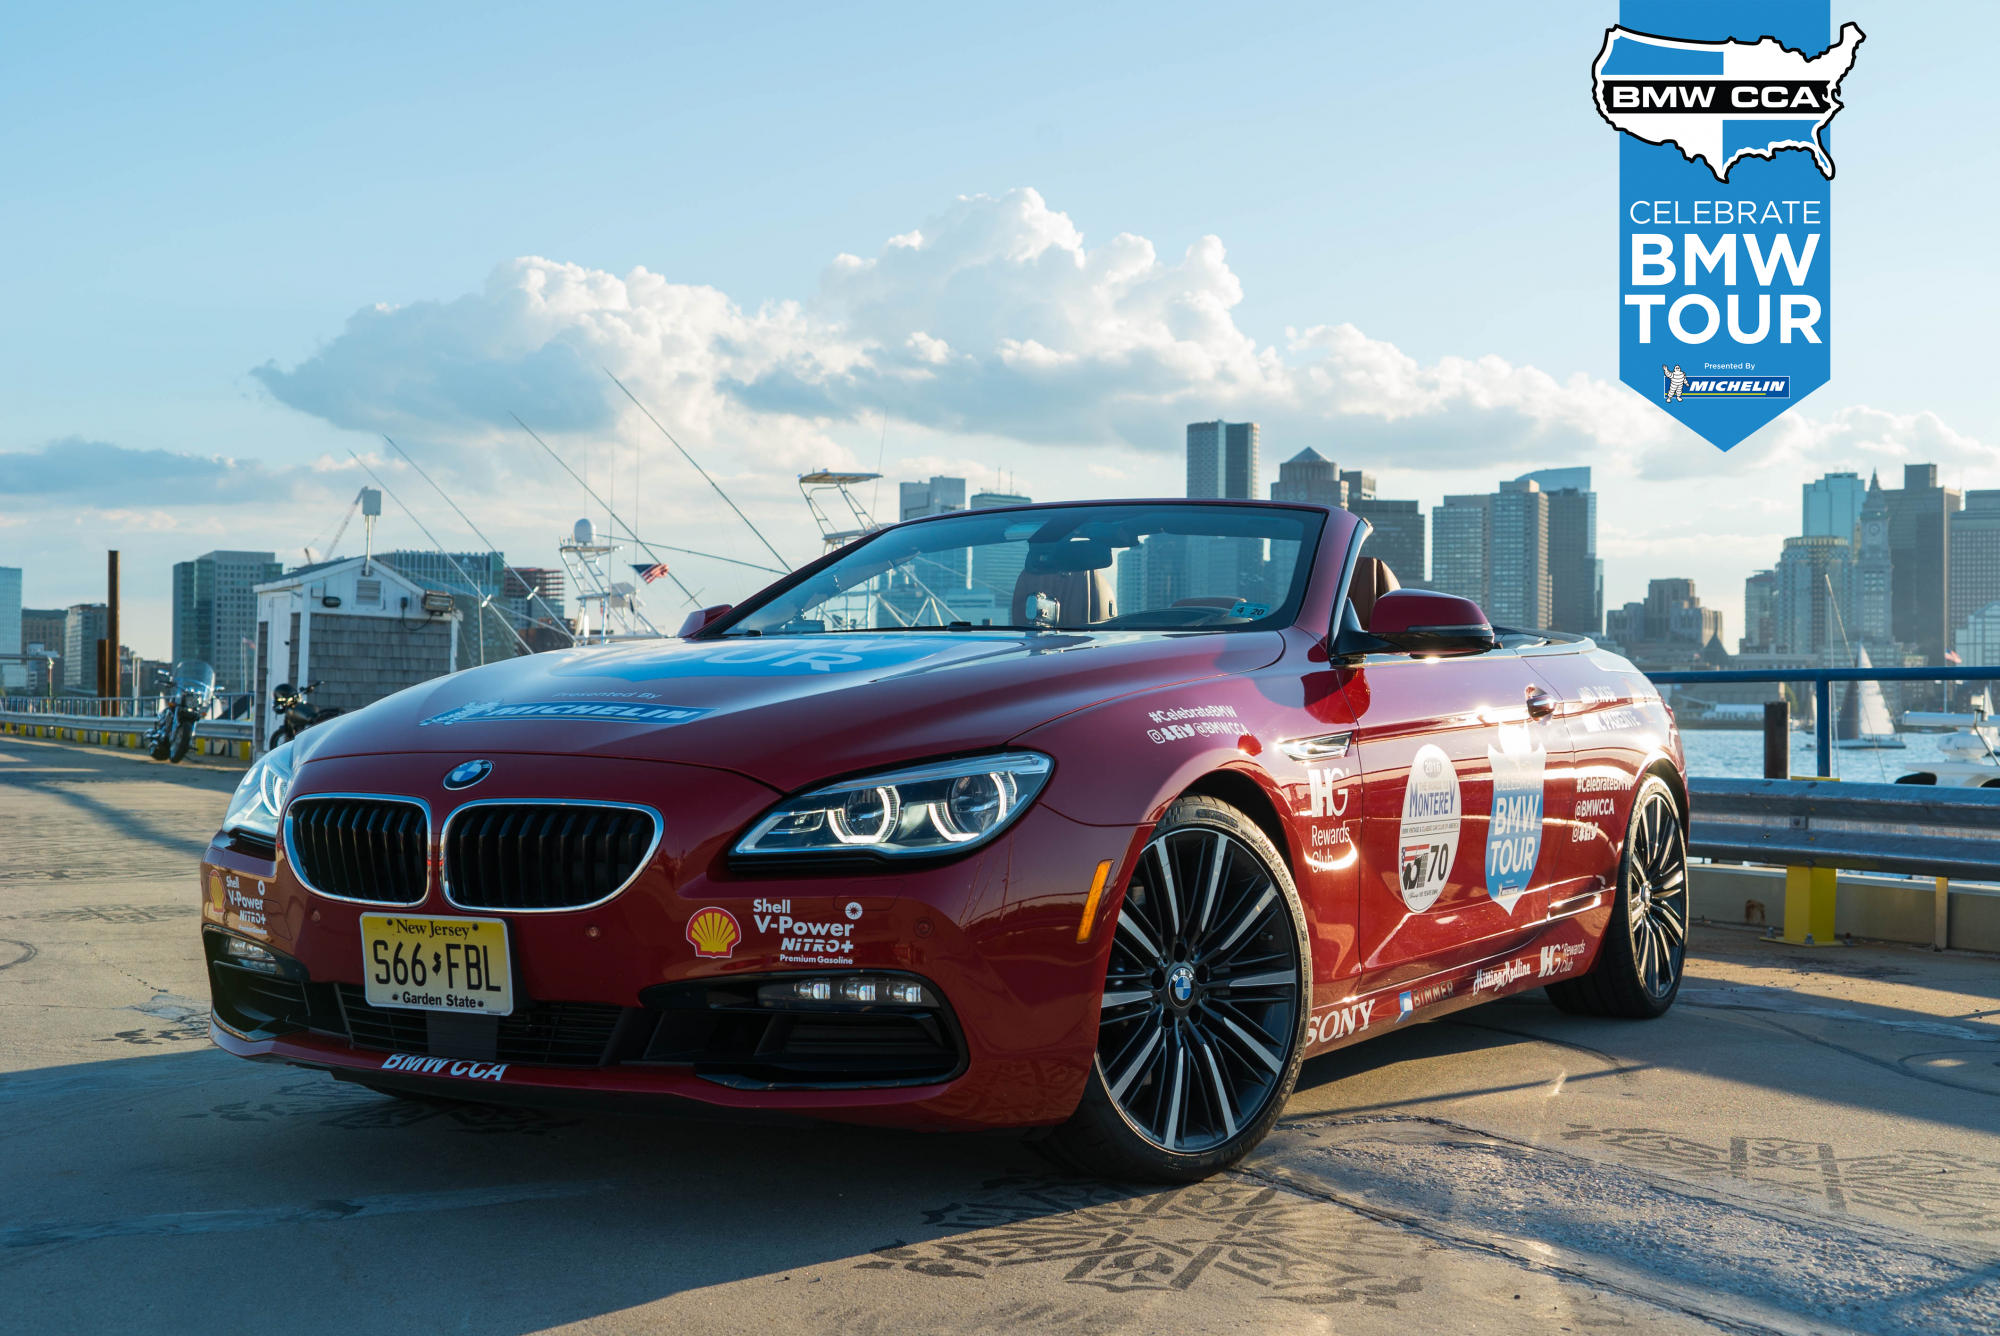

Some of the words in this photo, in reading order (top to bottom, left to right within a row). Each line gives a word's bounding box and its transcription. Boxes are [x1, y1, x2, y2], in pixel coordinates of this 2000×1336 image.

[1250, 608, 1265, 616] 20
[491, 704, 700, 719] MICHELIN
[1148, 705, 1238, 724] #CelebrateBMW
[1193, 722, 1252, 738] @BMWCCA
[1424, 760, 1441, 774] 2016
[1307, 767, 1349, 818] IHG
[1409, 780, 1456, 818] MONTEREY
[1494, 794, 1540, 836] BMW
[1575, 798, 1615, 821] @BMWCCA
[1311, 821, 1350, 847] Rewards
[1427, 843, 1449, 882] 70
[1490, 836, 1536, 877] TOUR
[226, 875, 240, 889] Shell
[227, 889, 264, 911] V-Power
[753, 898, 791, 914] Shell
[395, 919, 427, 935] New
[429, 920, 470, 941] Jersey
[753, 915, 855, 937] V-Power
[1564, 939, 1586, 957] Rewards
[373, 939, 427, 987] S66
[445, 943, 502, 992] FBL
[779, 954, 816, 964] Premium
[817, 955, 853, 965] Gasoline
[1538, 944, 1561, 978] IHG
[1560, 957, 1574, 973] Club
[402, 990, 442, 1006] Garden
[446, 993, 477, 1008] State
[1413, 980, 1455, 1008] BIMMER
[1305, 998, 1375, 1047] SONY
[381, 1053, 458, 1073] BMW
[450, 1060, 510, 1081] CCA
